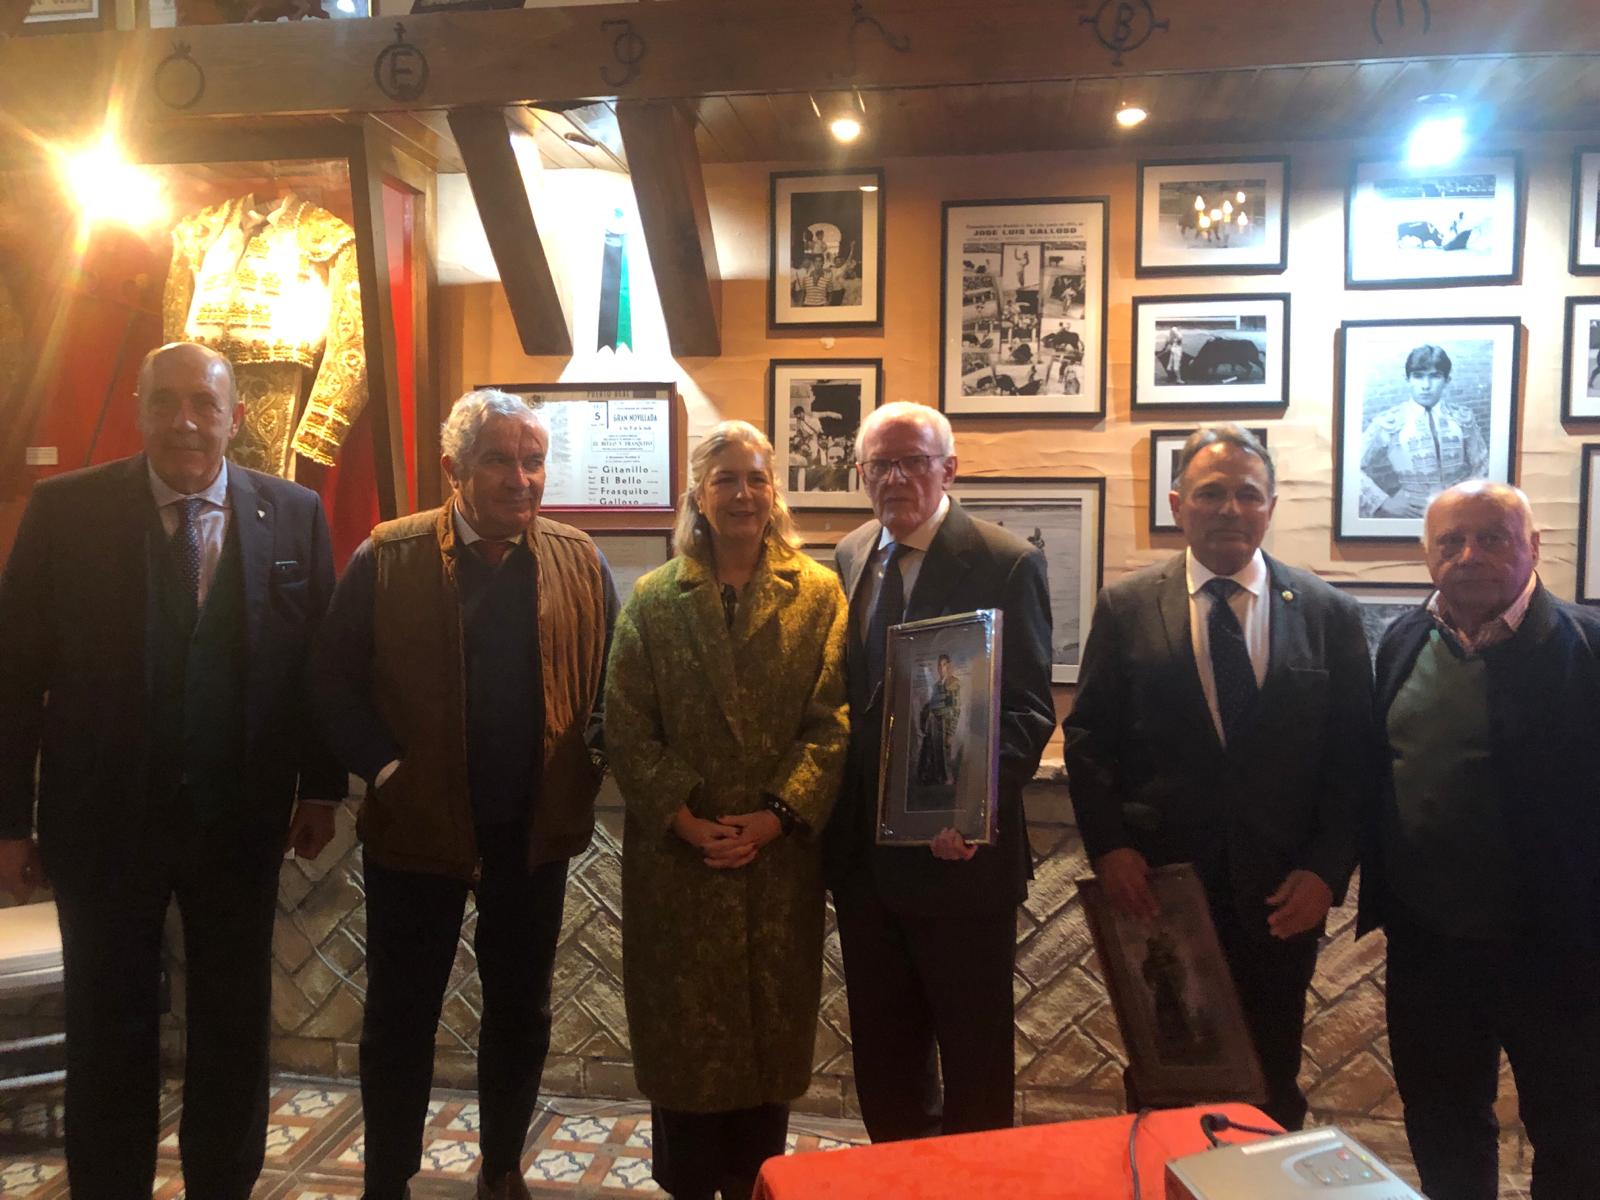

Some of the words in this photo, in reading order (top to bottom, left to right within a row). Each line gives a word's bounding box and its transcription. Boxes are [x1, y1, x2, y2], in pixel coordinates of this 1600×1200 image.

[1029, 227, 1077, 235] GALLOSO
[613, 413, 628, 422] GRAN
[630, 413, 658, 422] NOVILLADA
[602, 465, 649, 474] Gitanillo
[600, 476, 609, 485] El
[615, 476, 642, 485] Bello
[600, 486, 649, 497] Frasquito
[599, 497, 639, 505] Galloso
